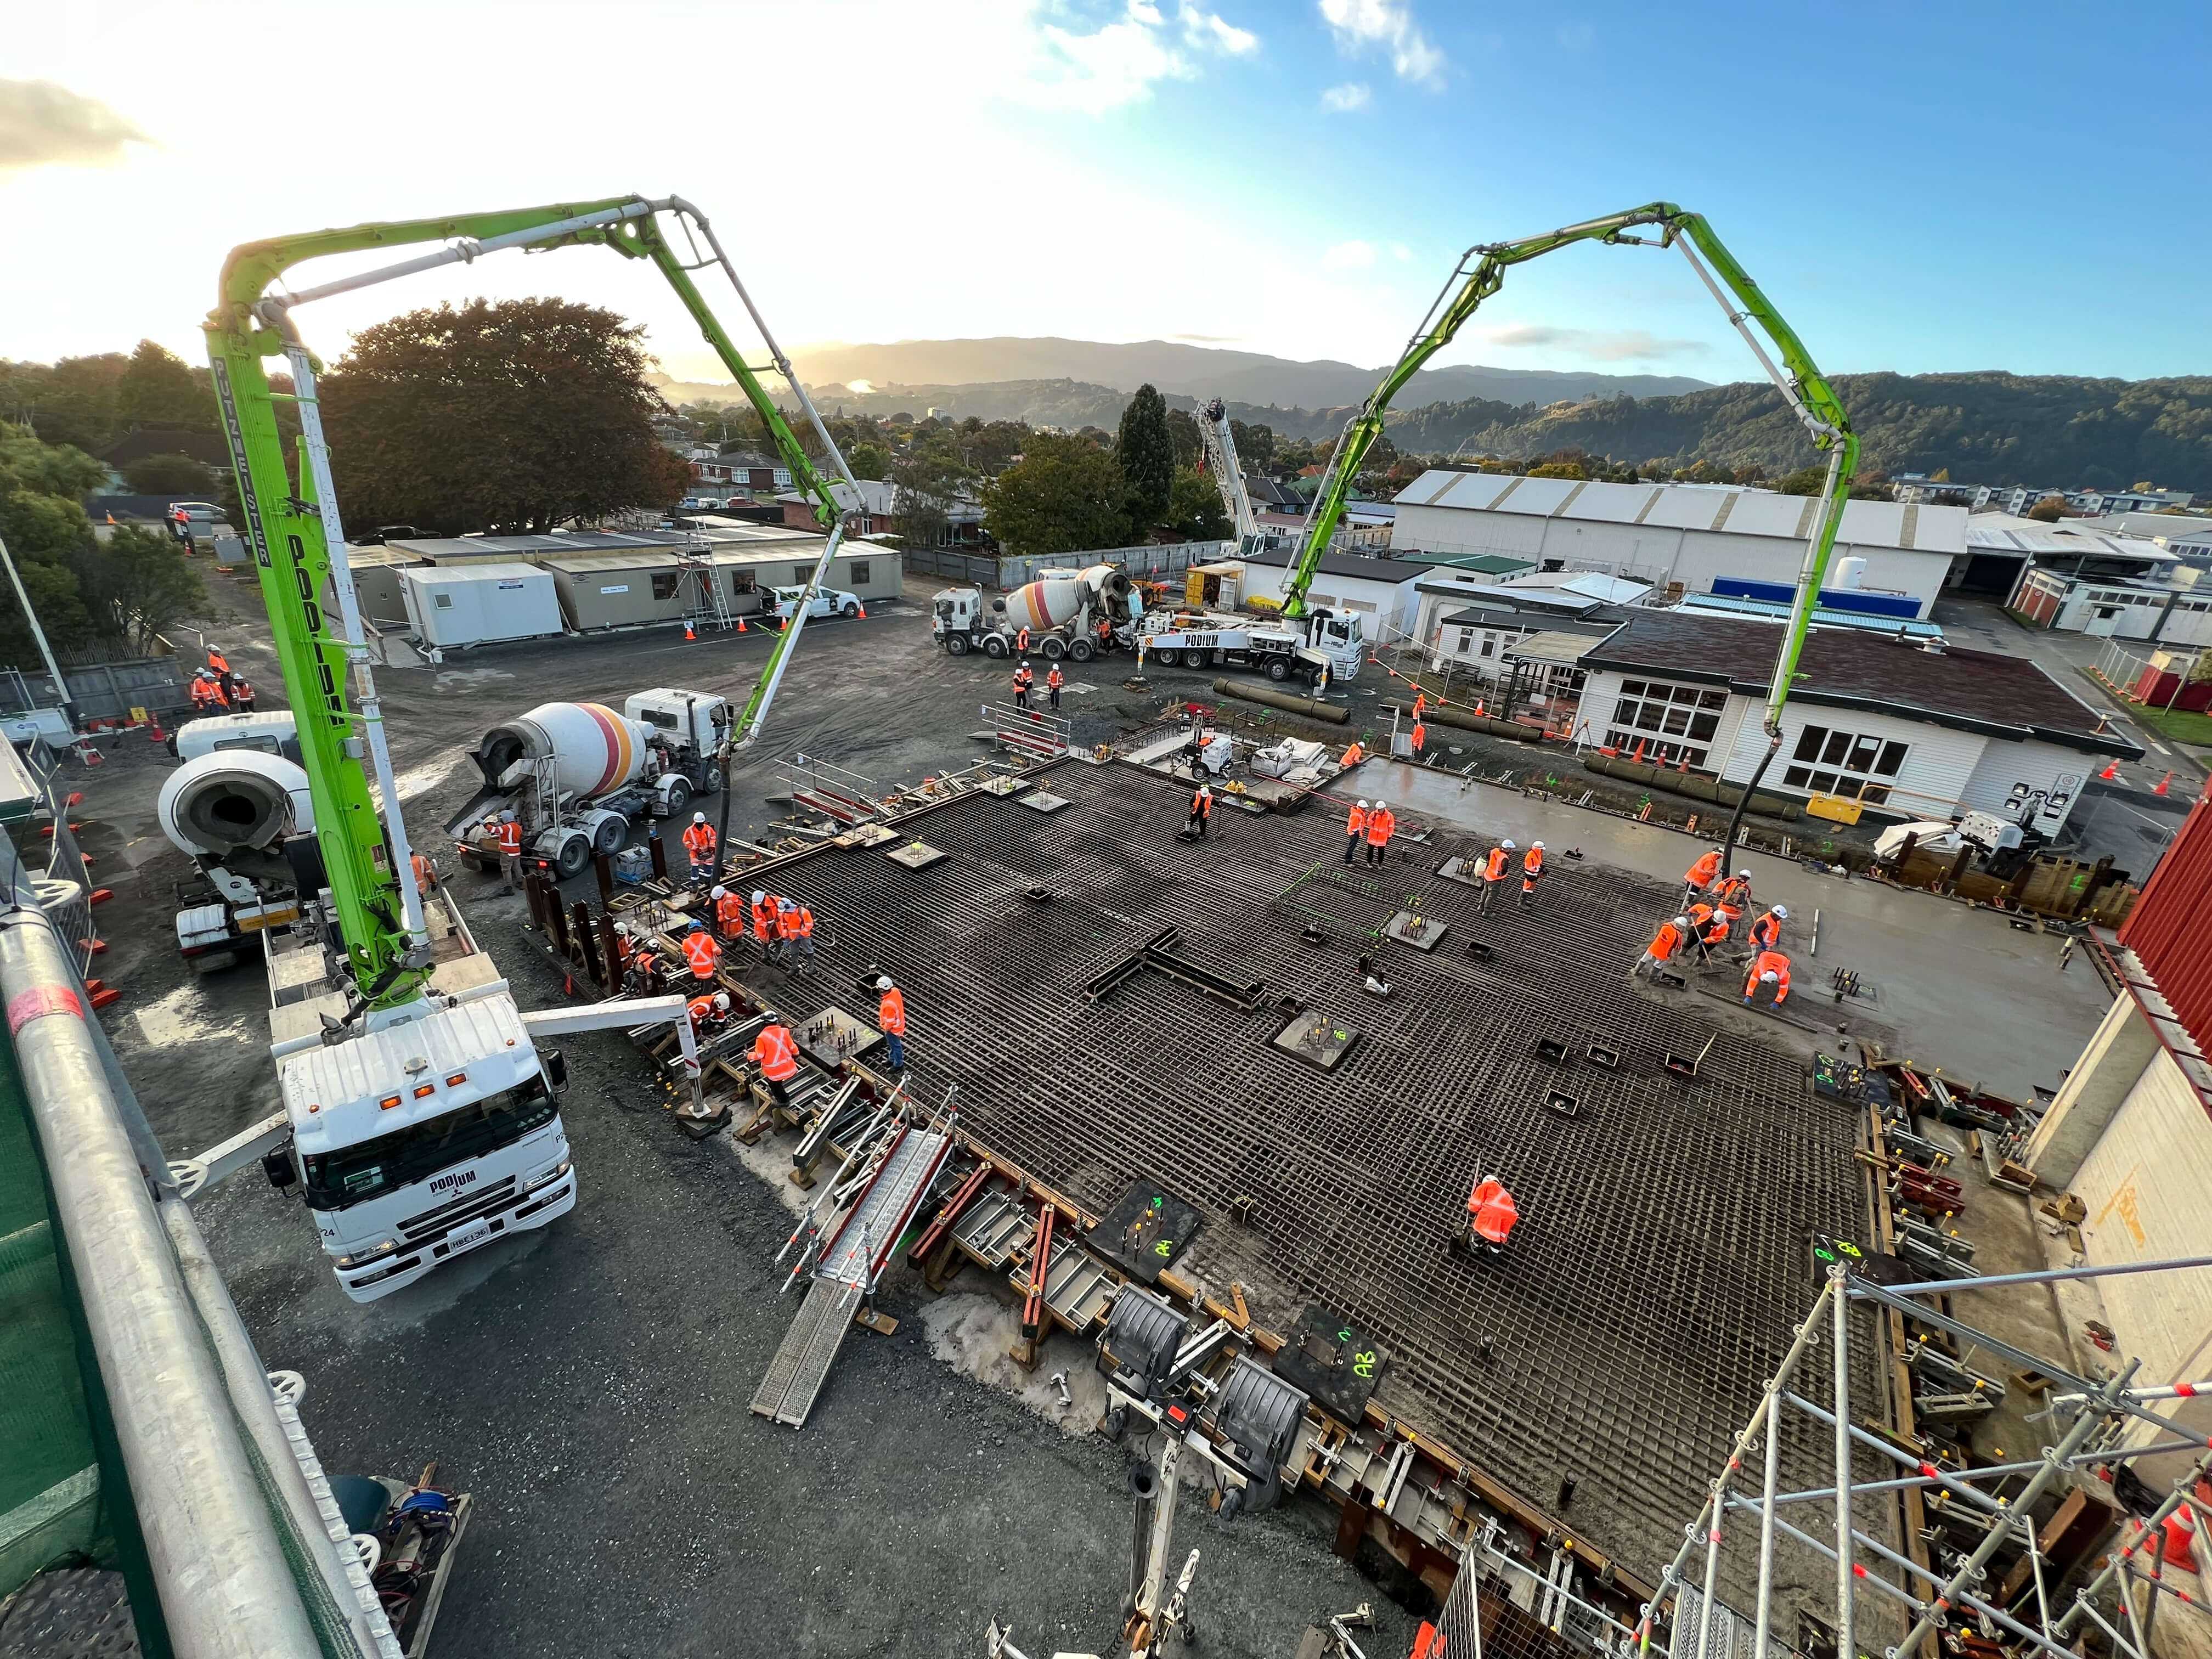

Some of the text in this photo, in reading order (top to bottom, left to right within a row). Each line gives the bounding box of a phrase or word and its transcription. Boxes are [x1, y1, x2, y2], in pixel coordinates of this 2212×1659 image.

[215, 360, 269, 564] PUTZMEISTER
[287, 535, 346, 726] PODIUM
[1185, 635, 1218, 646] PODIUM
[1821, 842, 1835, 853] 2
[429, 1170, 477, 1193] PODIUM
